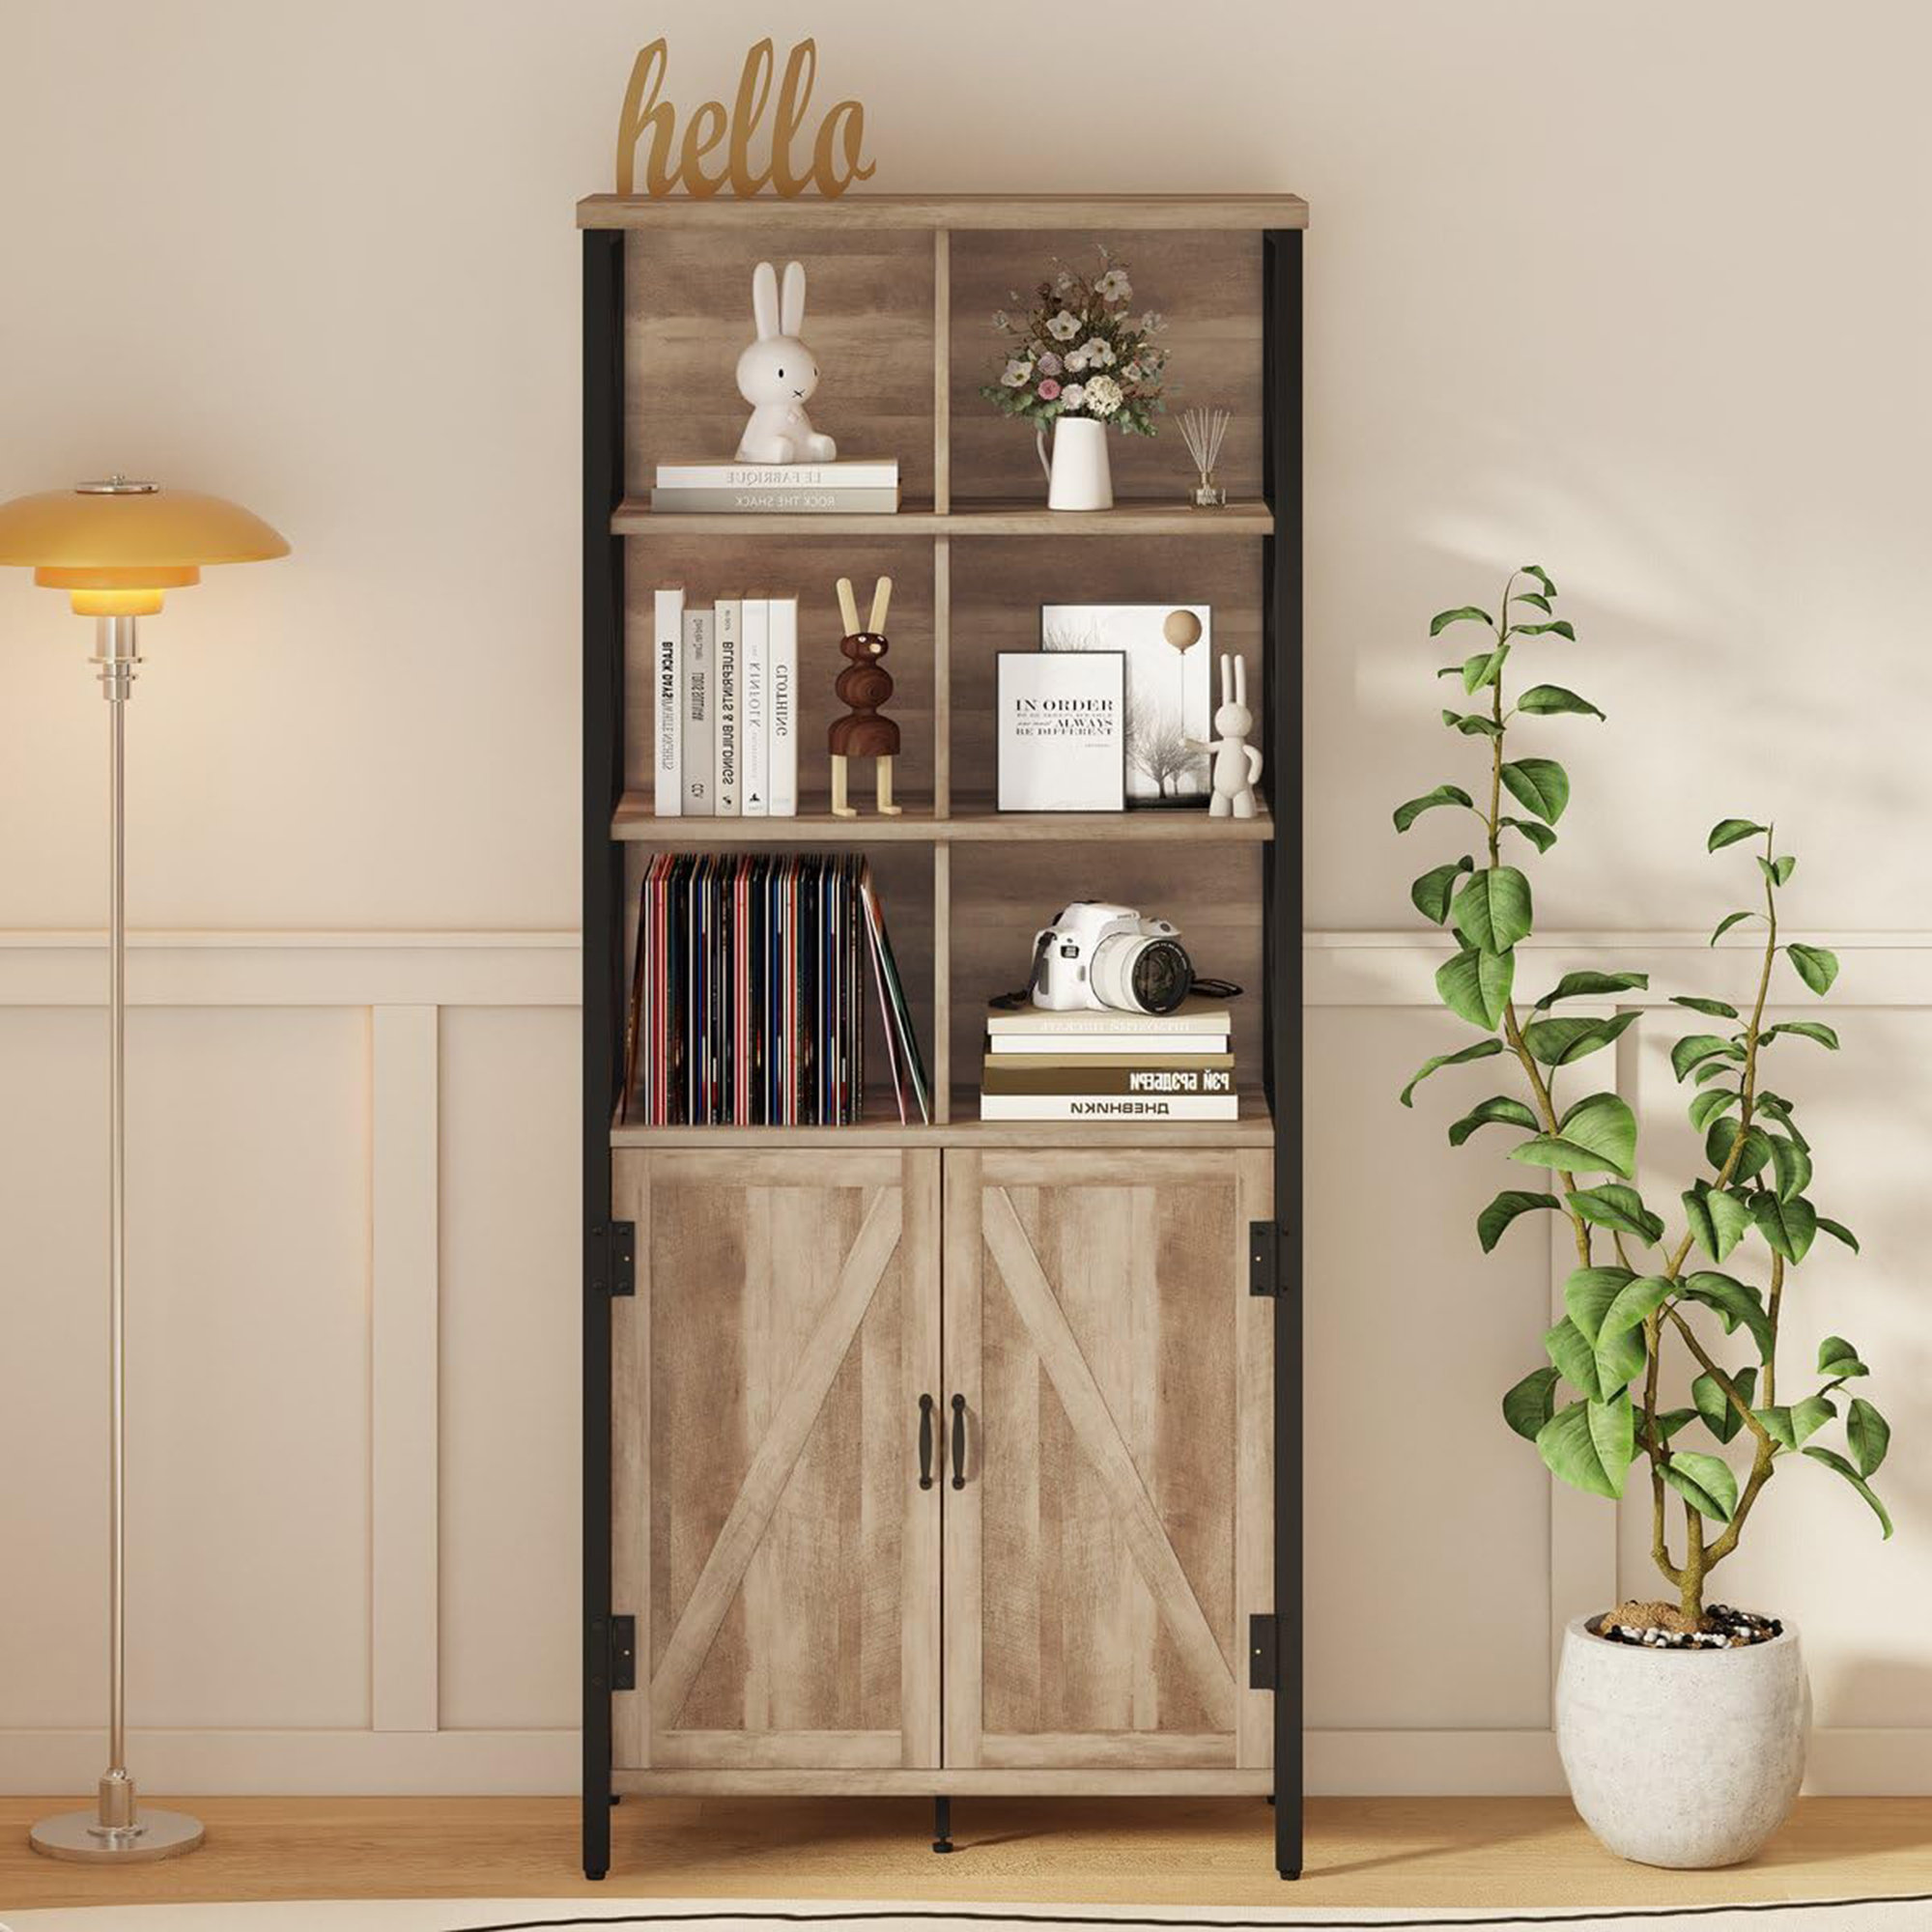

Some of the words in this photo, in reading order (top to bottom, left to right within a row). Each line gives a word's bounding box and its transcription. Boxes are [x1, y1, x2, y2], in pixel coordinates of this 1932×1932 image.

[616, 37, 876, 199] hello
[1016, 699, 1037, 711] IN
[1042, 699, 1113, 711] ORDER
[1056, 719, 1113, 727] ALWAYS
